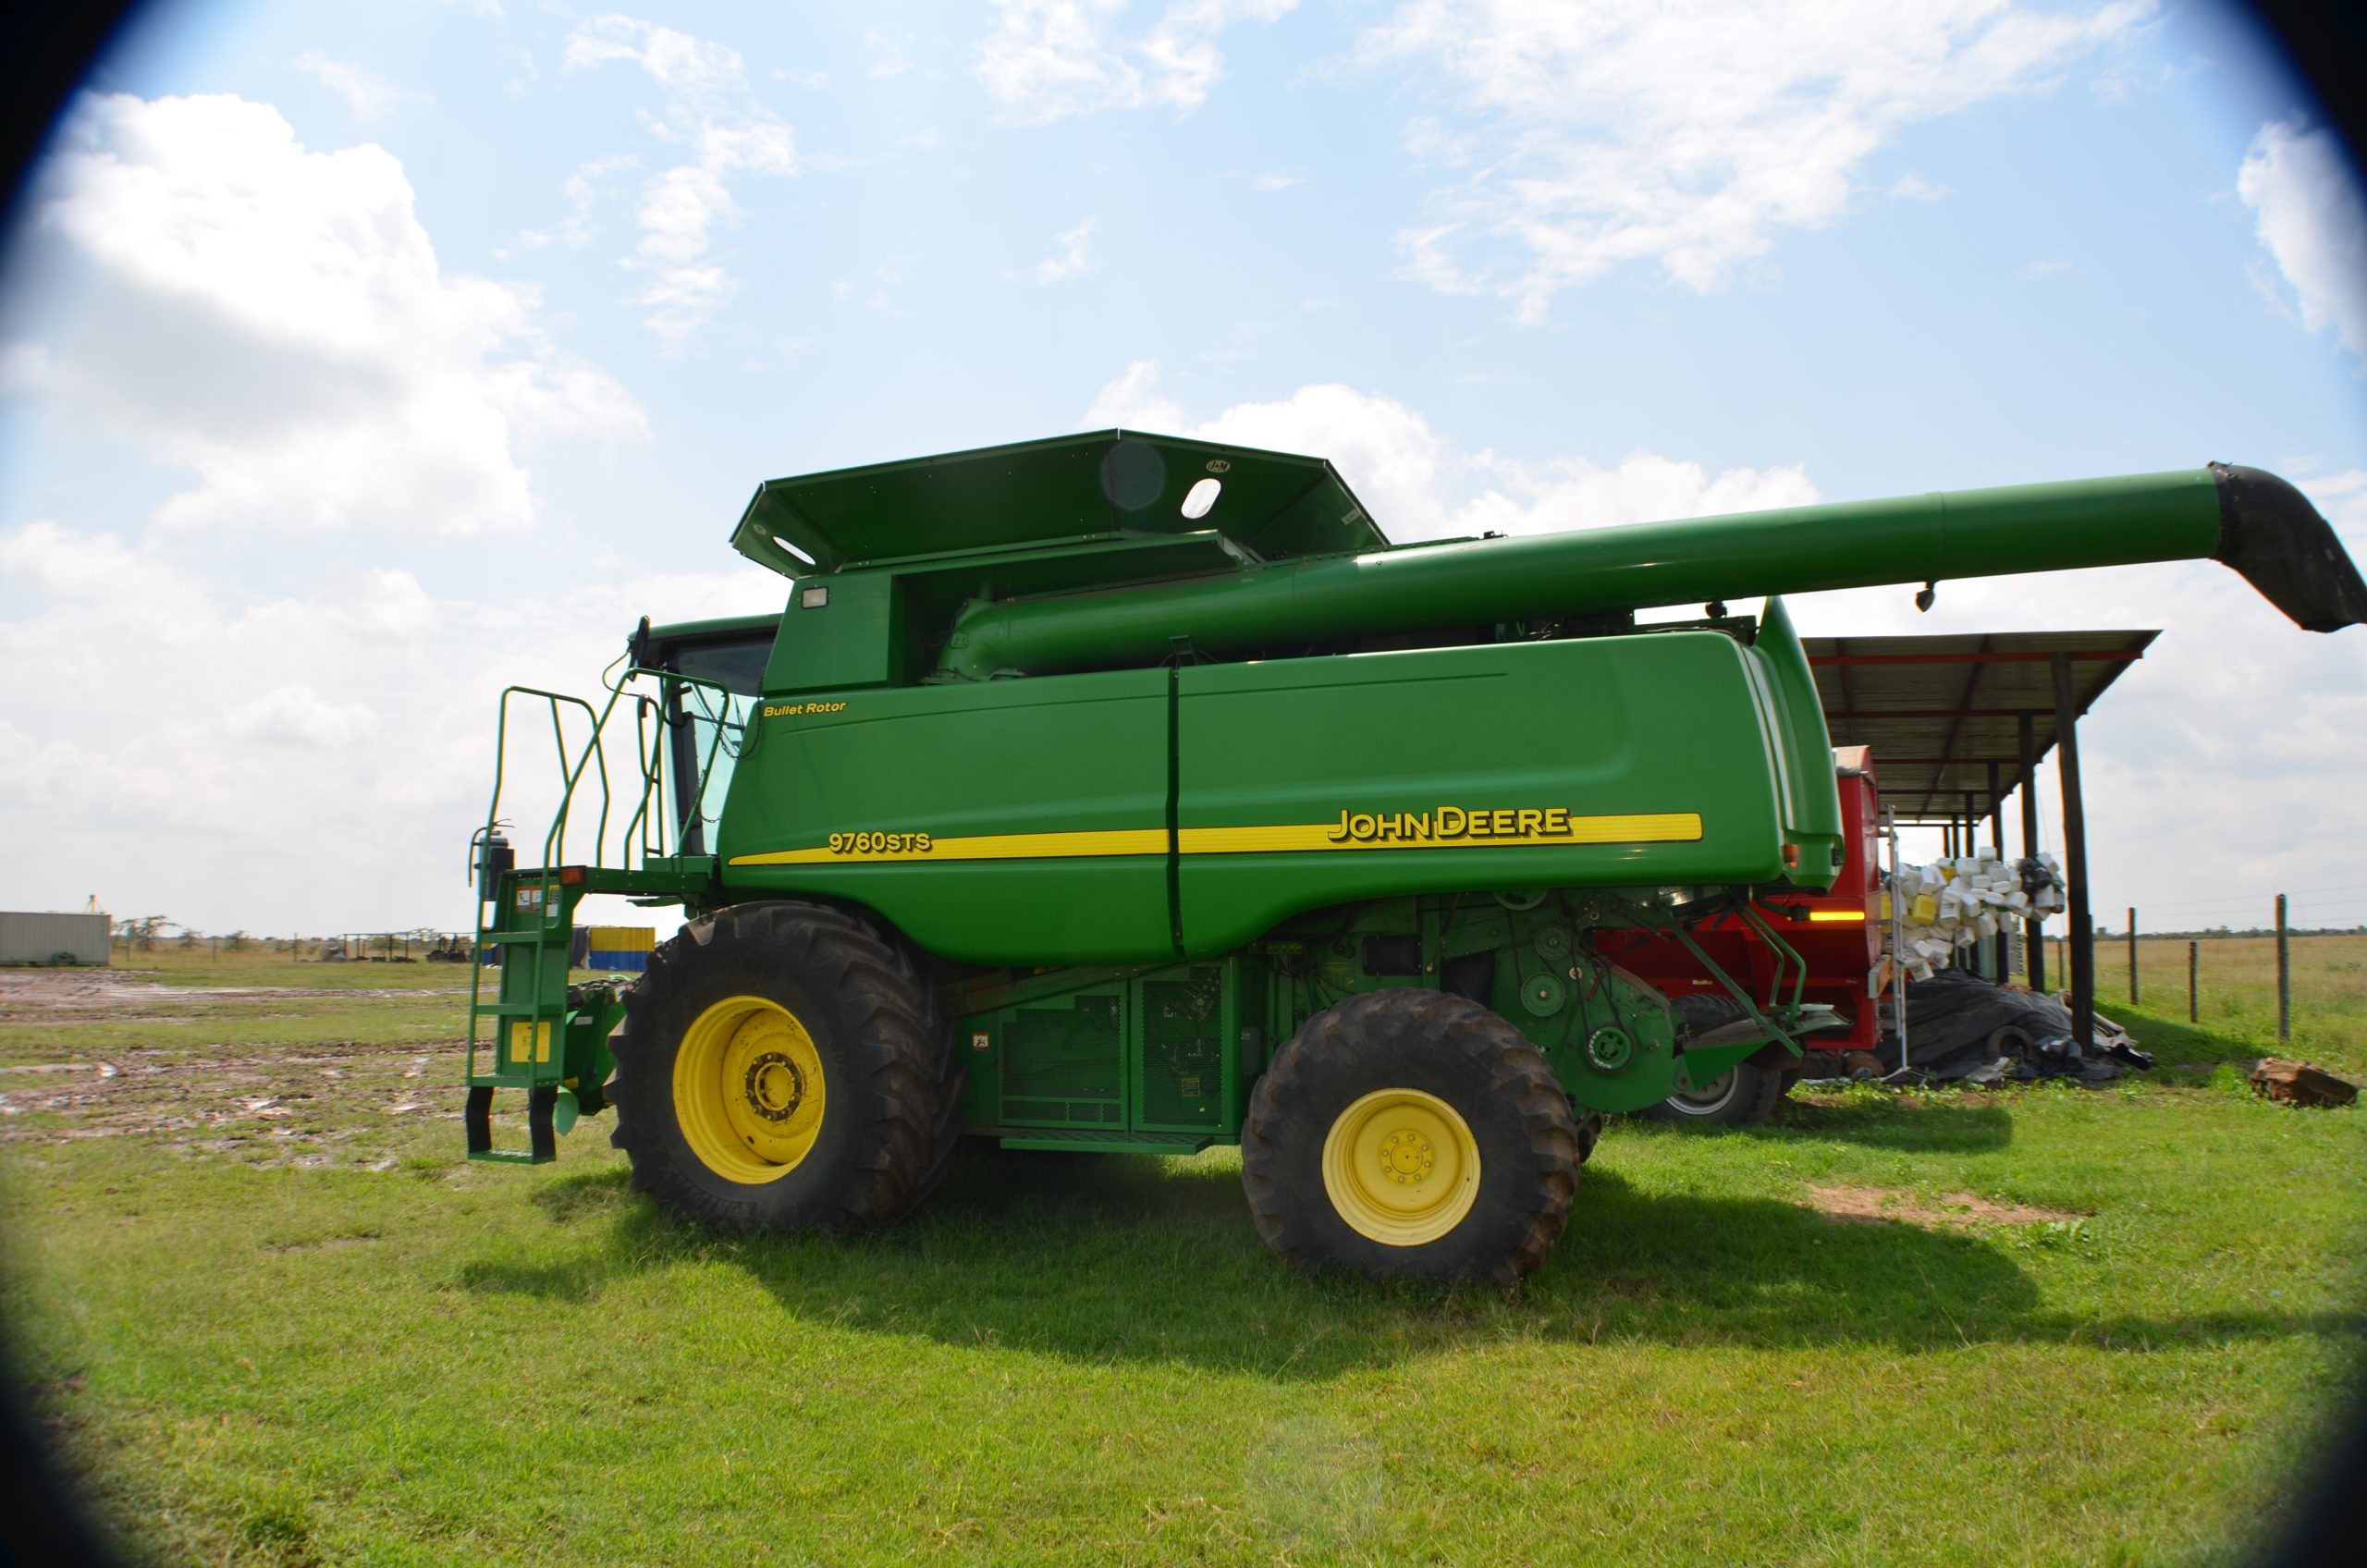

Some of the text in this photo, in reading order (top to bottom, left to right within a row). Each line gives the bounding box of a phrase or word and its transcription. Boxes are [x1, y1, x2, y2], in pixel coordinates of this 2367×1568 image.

[763, 702, 847, 717] Bullet Rotor
[1328, 805, 1573, 841] JOHN DEERE
[828, 831, 933, 853] 9760STS
